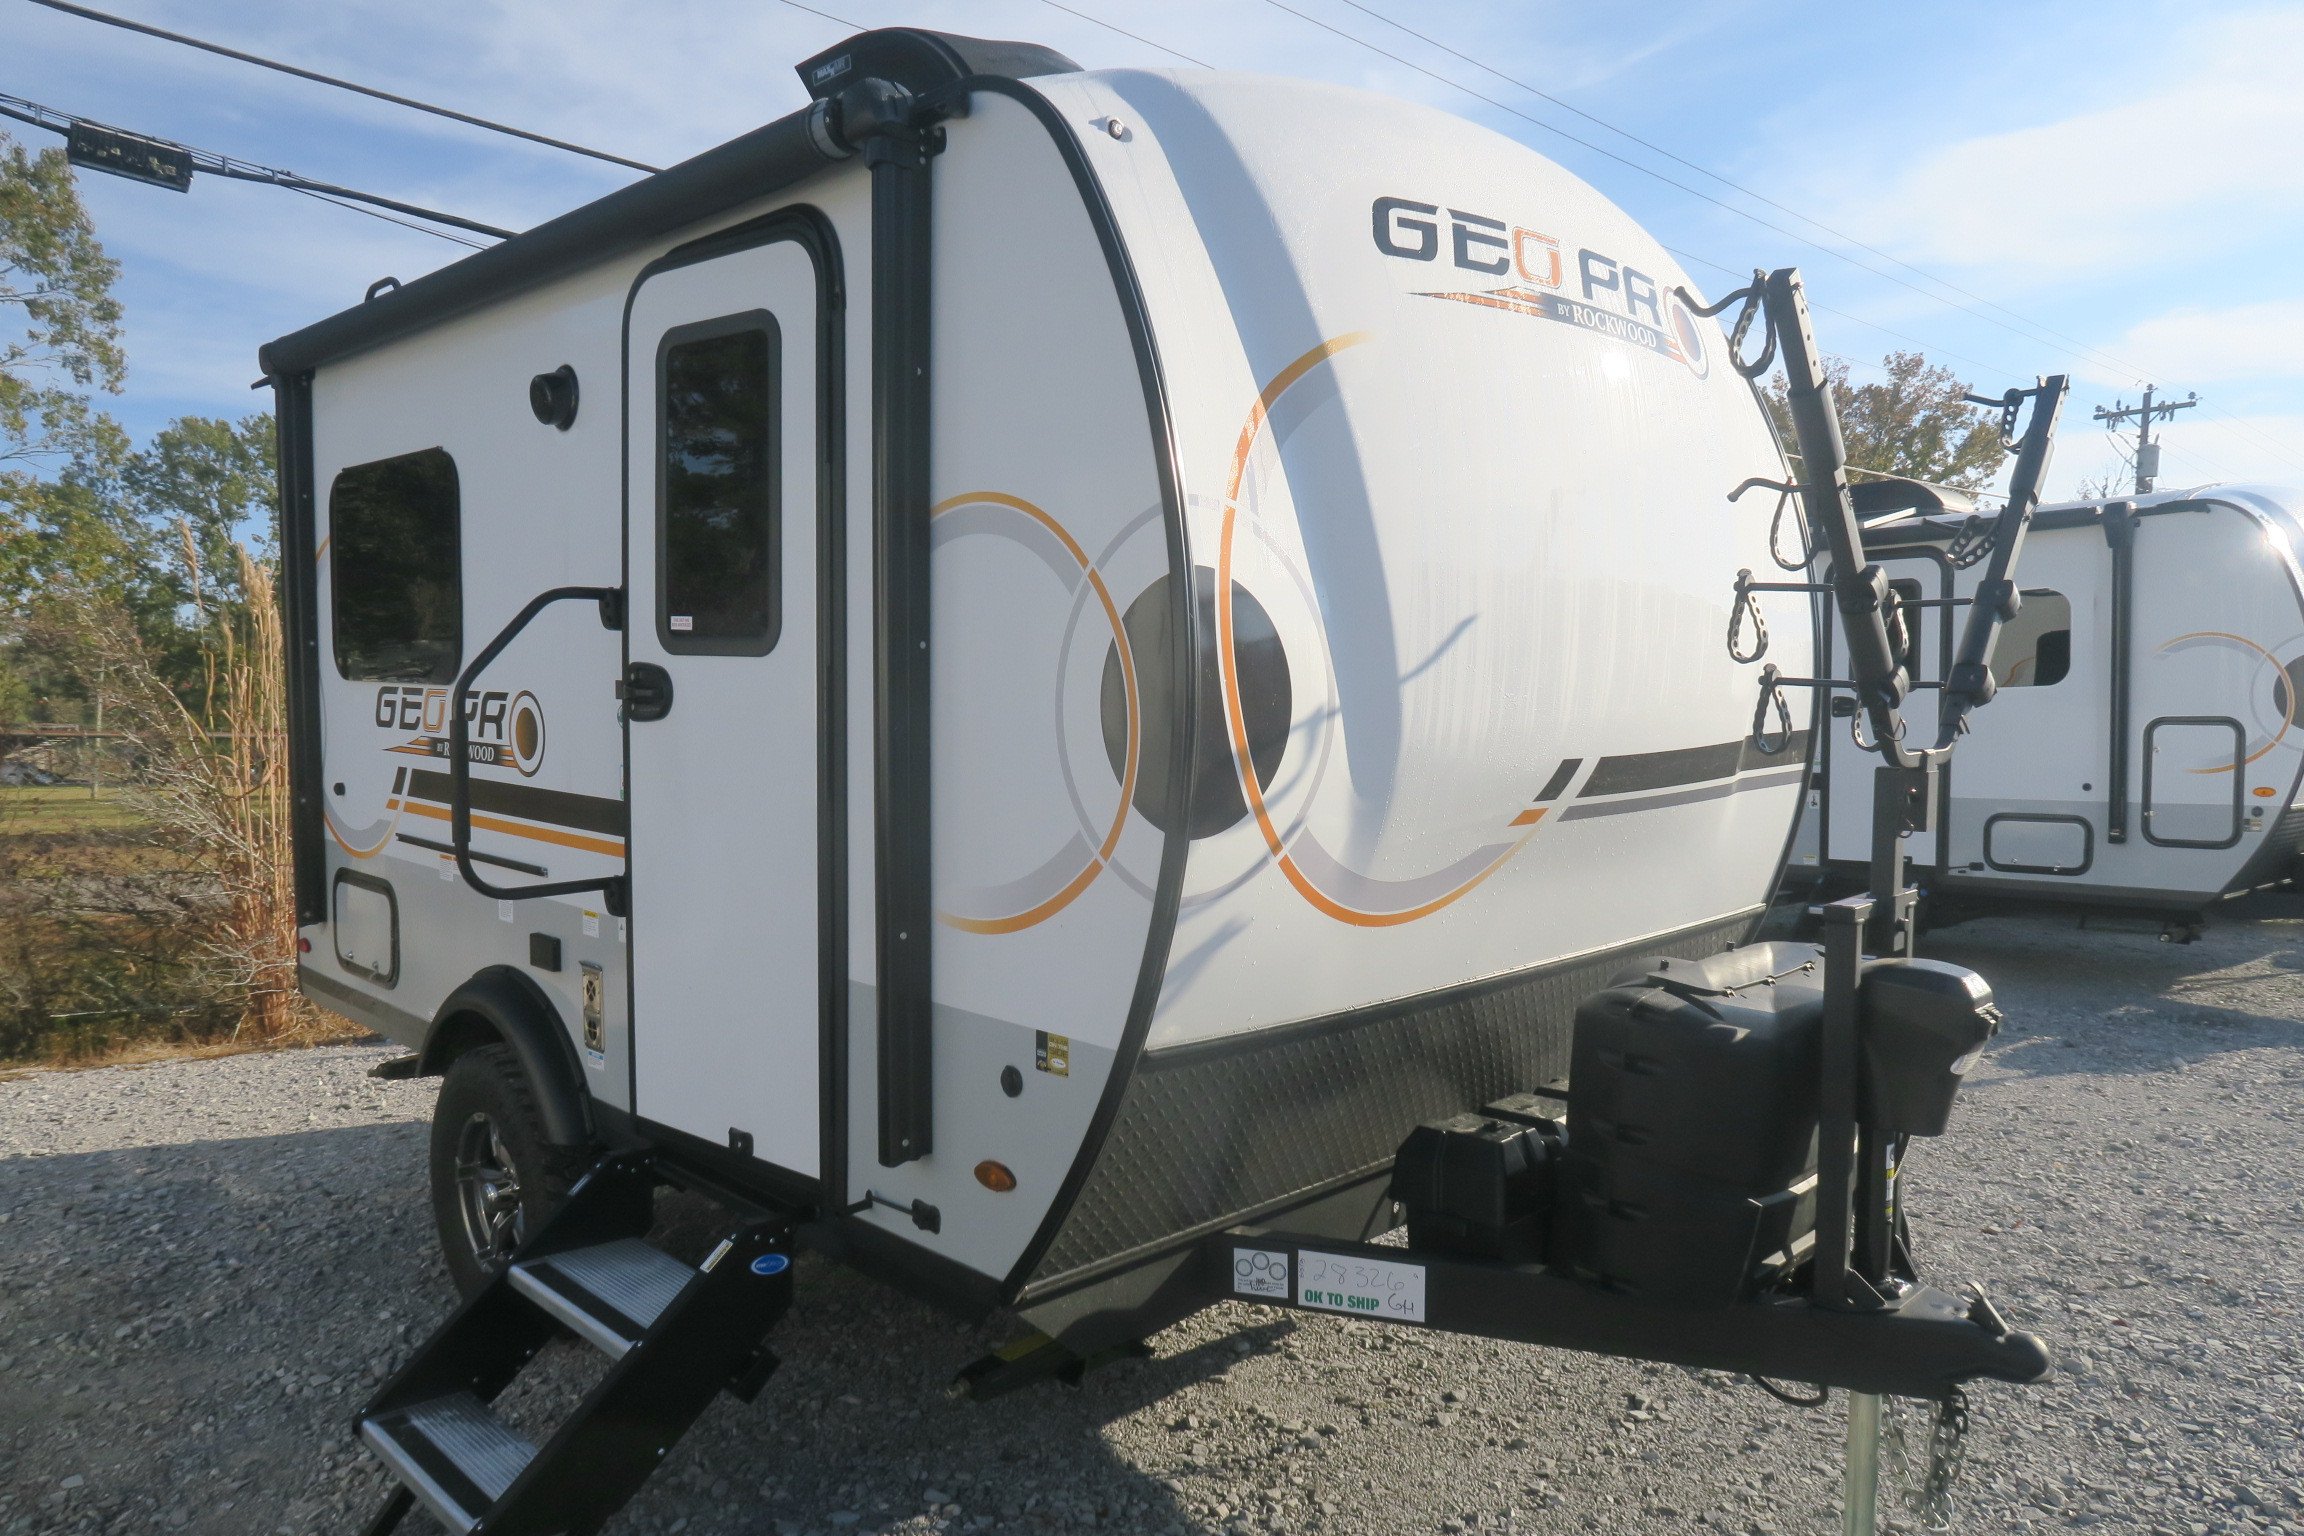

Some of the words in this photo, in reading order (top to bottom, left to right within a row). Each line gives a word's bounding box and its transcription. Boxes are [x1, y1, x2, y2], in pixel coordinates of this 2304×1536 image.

[1372, 196, 1562, 289] GEO
[1557, 303, 1570, 317] BY
[1571, 304, 1657, 348] ROCKWOOD
[375, 686, 449, 733] GEO
[444, 742, 495, 762] RWOOD
[1304, 1289, 1323, 1304] OK
[1327, 1292, 1344, 1307] TO
[1347, 1295, 1380, 1311] SHIP
